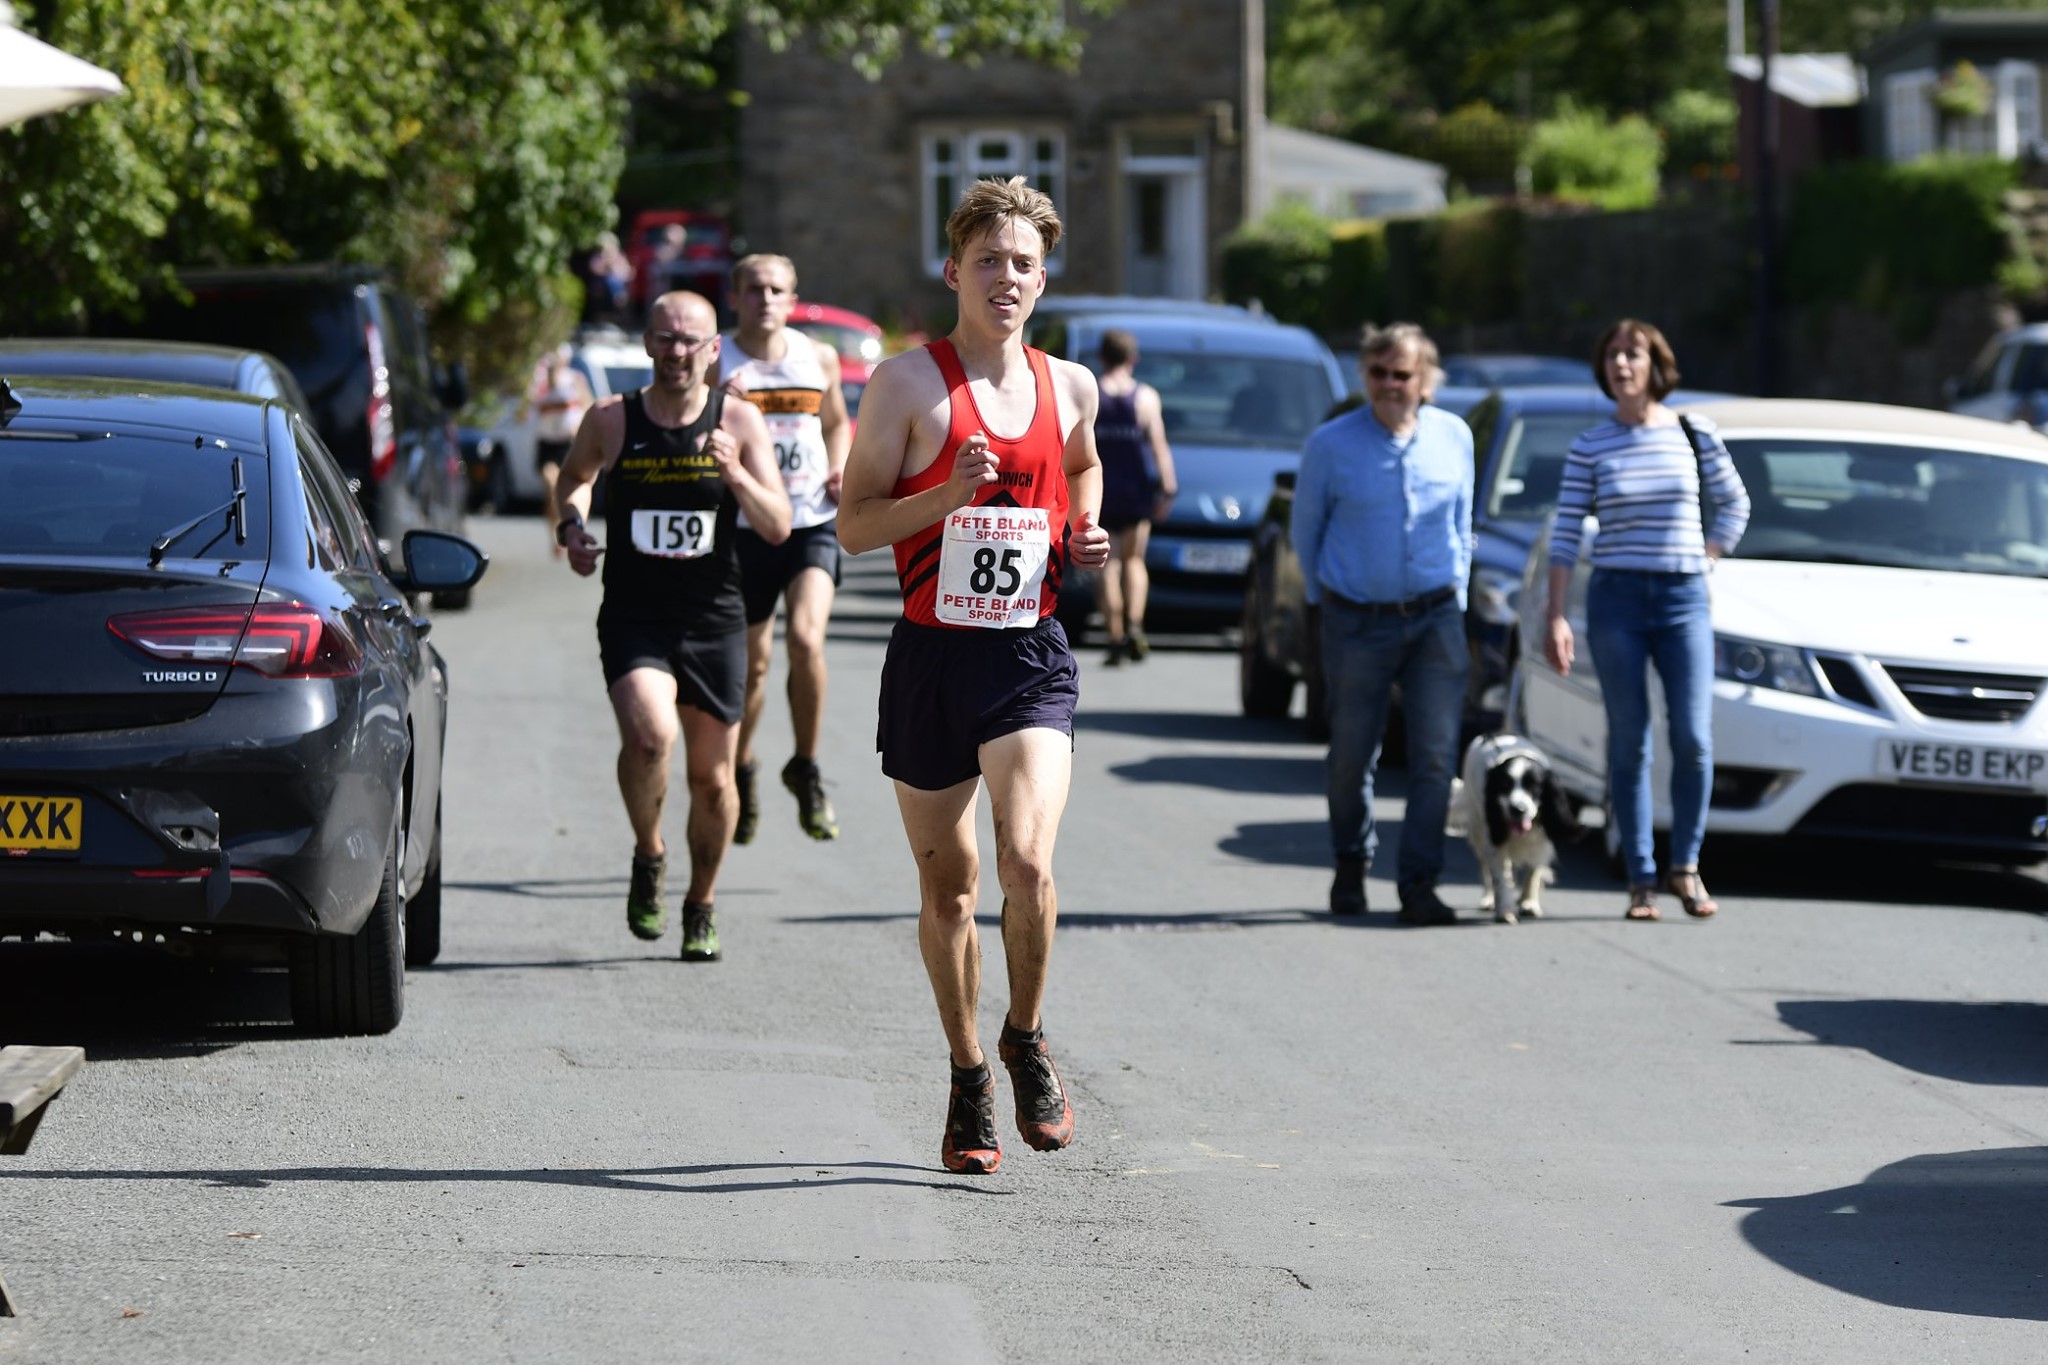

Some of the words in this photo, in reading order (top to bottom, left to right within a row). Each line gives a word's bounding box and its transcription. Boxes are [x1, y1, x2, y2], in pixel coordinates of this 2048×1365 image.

[671, 456, 719, 467] VALLE
[988, 471, 1034, 488] RWICH
[951, 515, 992, 529] PETE
[997, 518, 1047, 531] BLAND
[653, 515, 703, 550] 159
[975, 531, 1024, 541] SPORTS
[969, 547, 1022, 596] 85
[943, 594, 986, 609] PETE
[142, 671, 201, 683] TURBO
[204, 671, 217, 682] D
[1891, 744, 1973, 776] VE58
[1983, 751, 2045, 780] EKP
